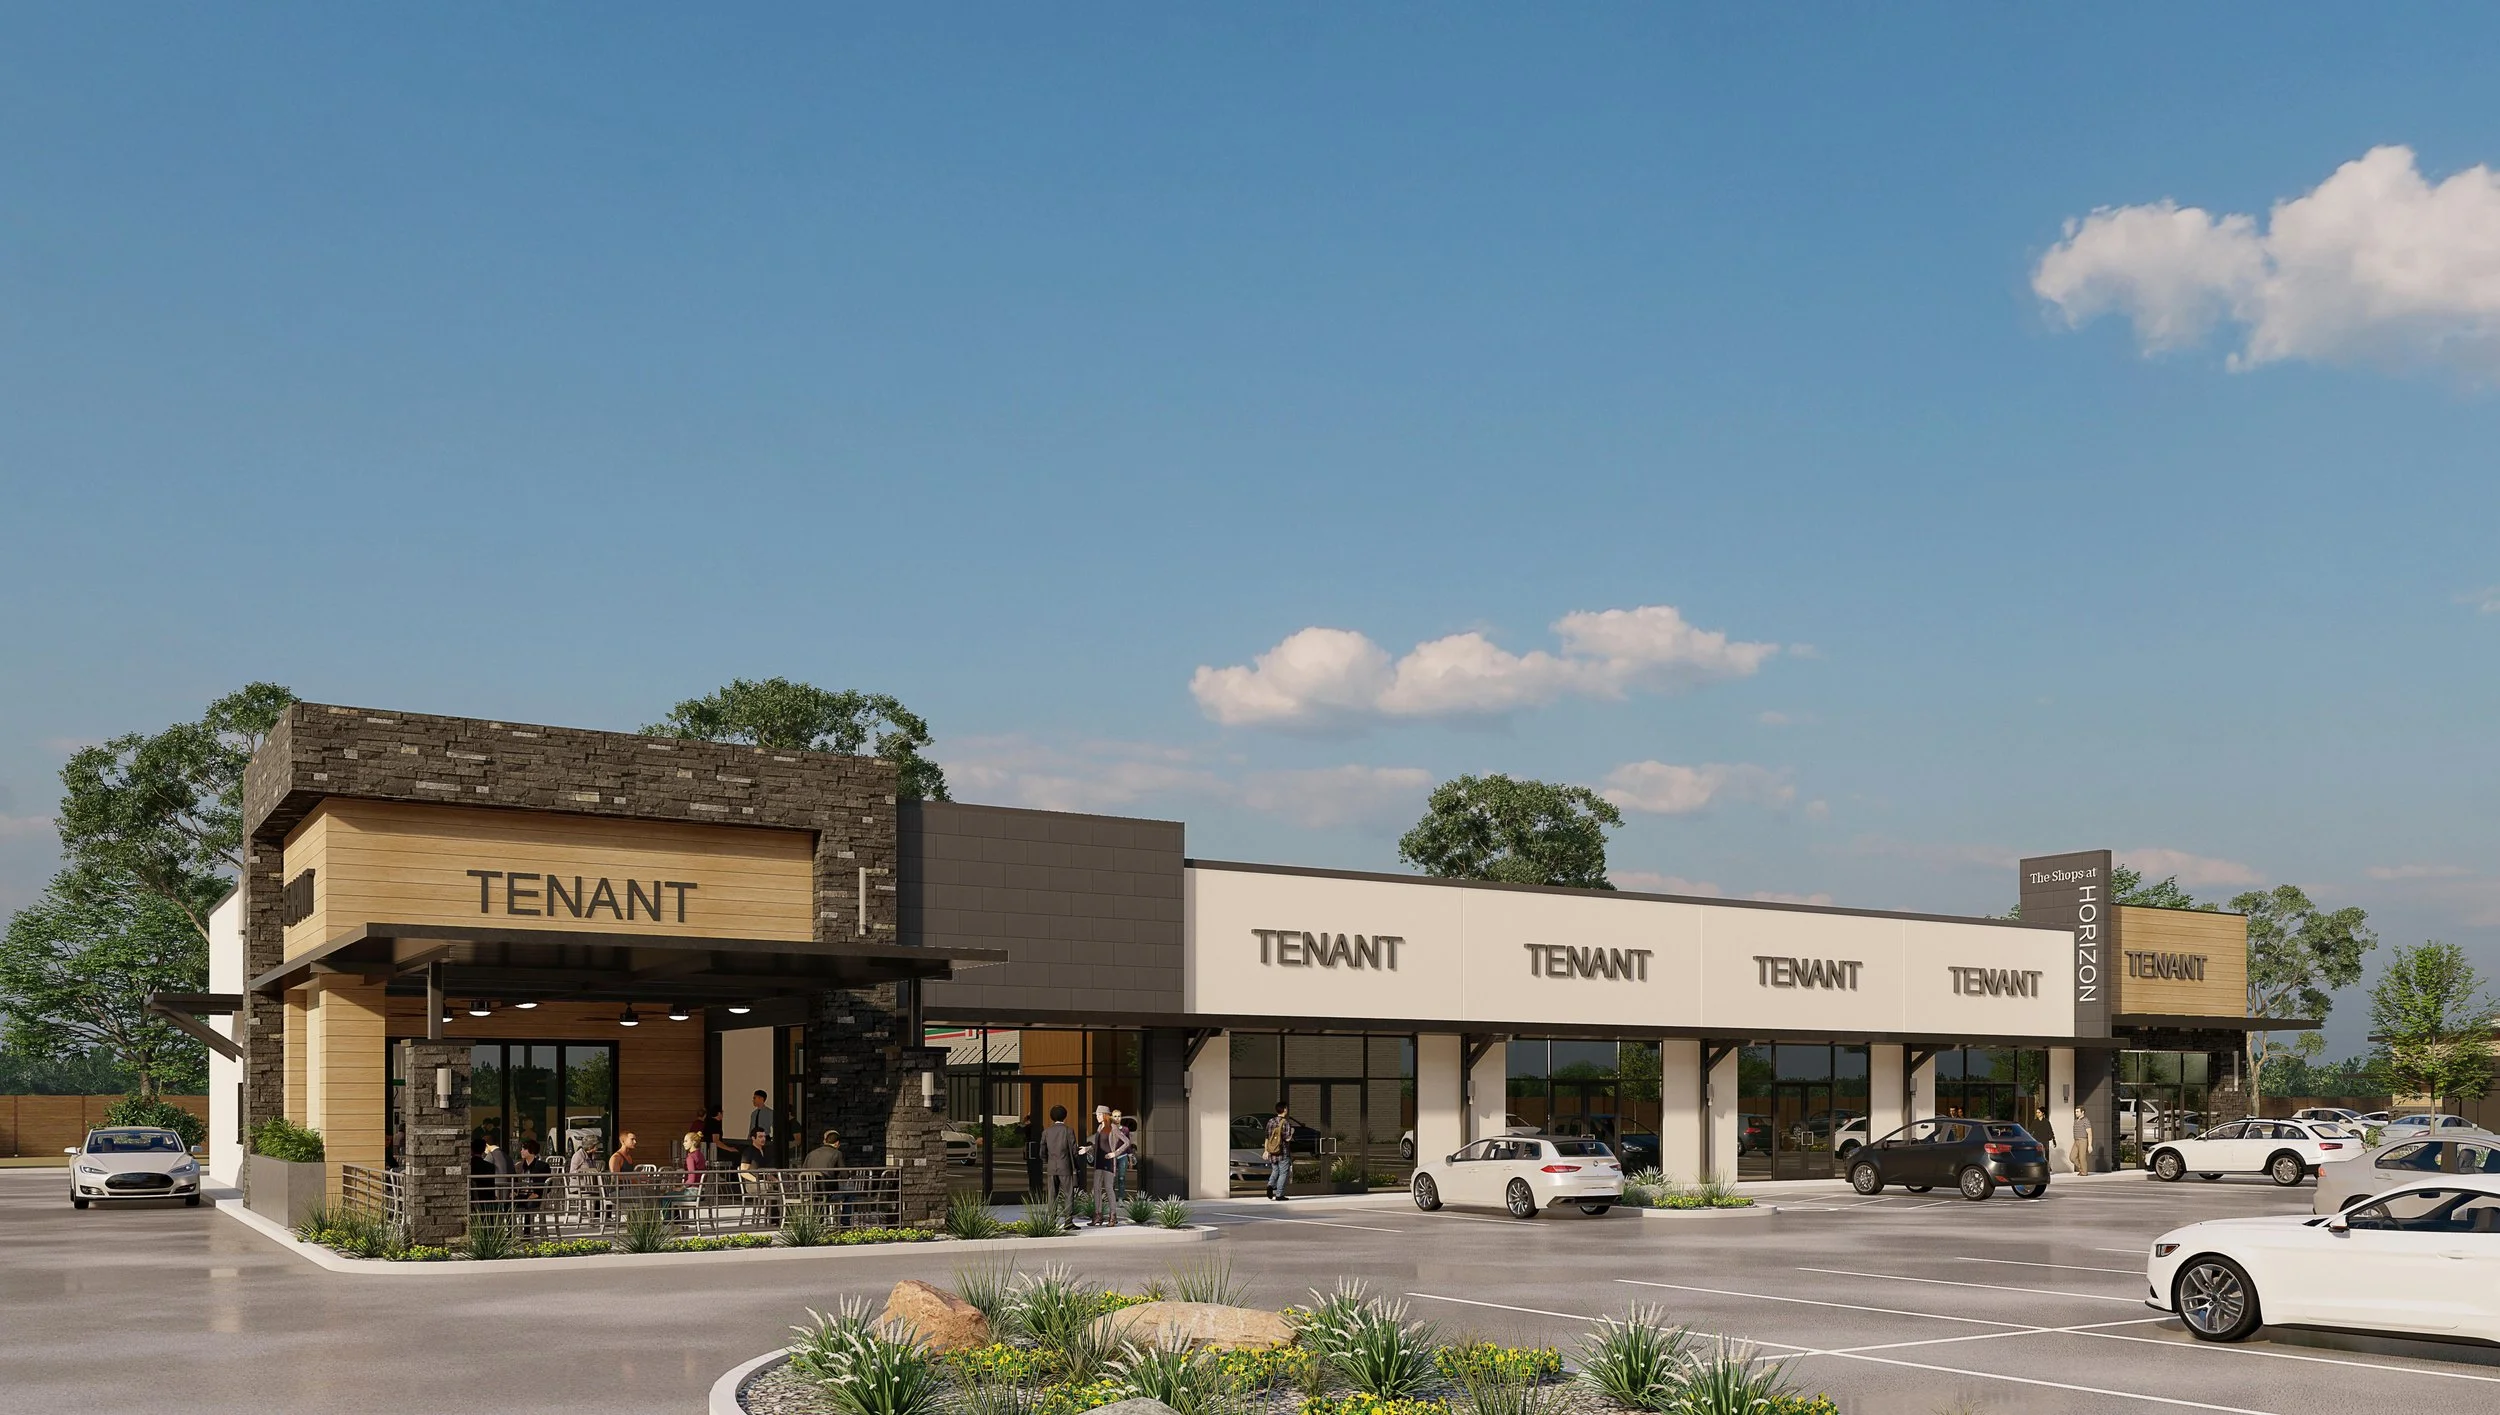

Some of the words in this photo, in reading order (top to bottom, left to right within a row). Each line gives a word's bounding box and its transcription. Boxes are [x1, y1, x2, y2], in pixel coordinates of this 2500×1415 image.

[2030, 872, 2050, 884] The
[2051, 868, 2084, 883] Shops
[2085, 866, 2097, 878] at
[466, 869, 698, 923] TENANT
[1250, 928, 1405, 970] TENANT
[2078, 885, 2097, 1002] HORIZON
[1523, 943, 1653, 981] TENANT
[1752, 955, 1863, 990] TENANT
[2124, 950, 2208, 981] TENANT
[1947, 966, 2043, 999] TENANT
